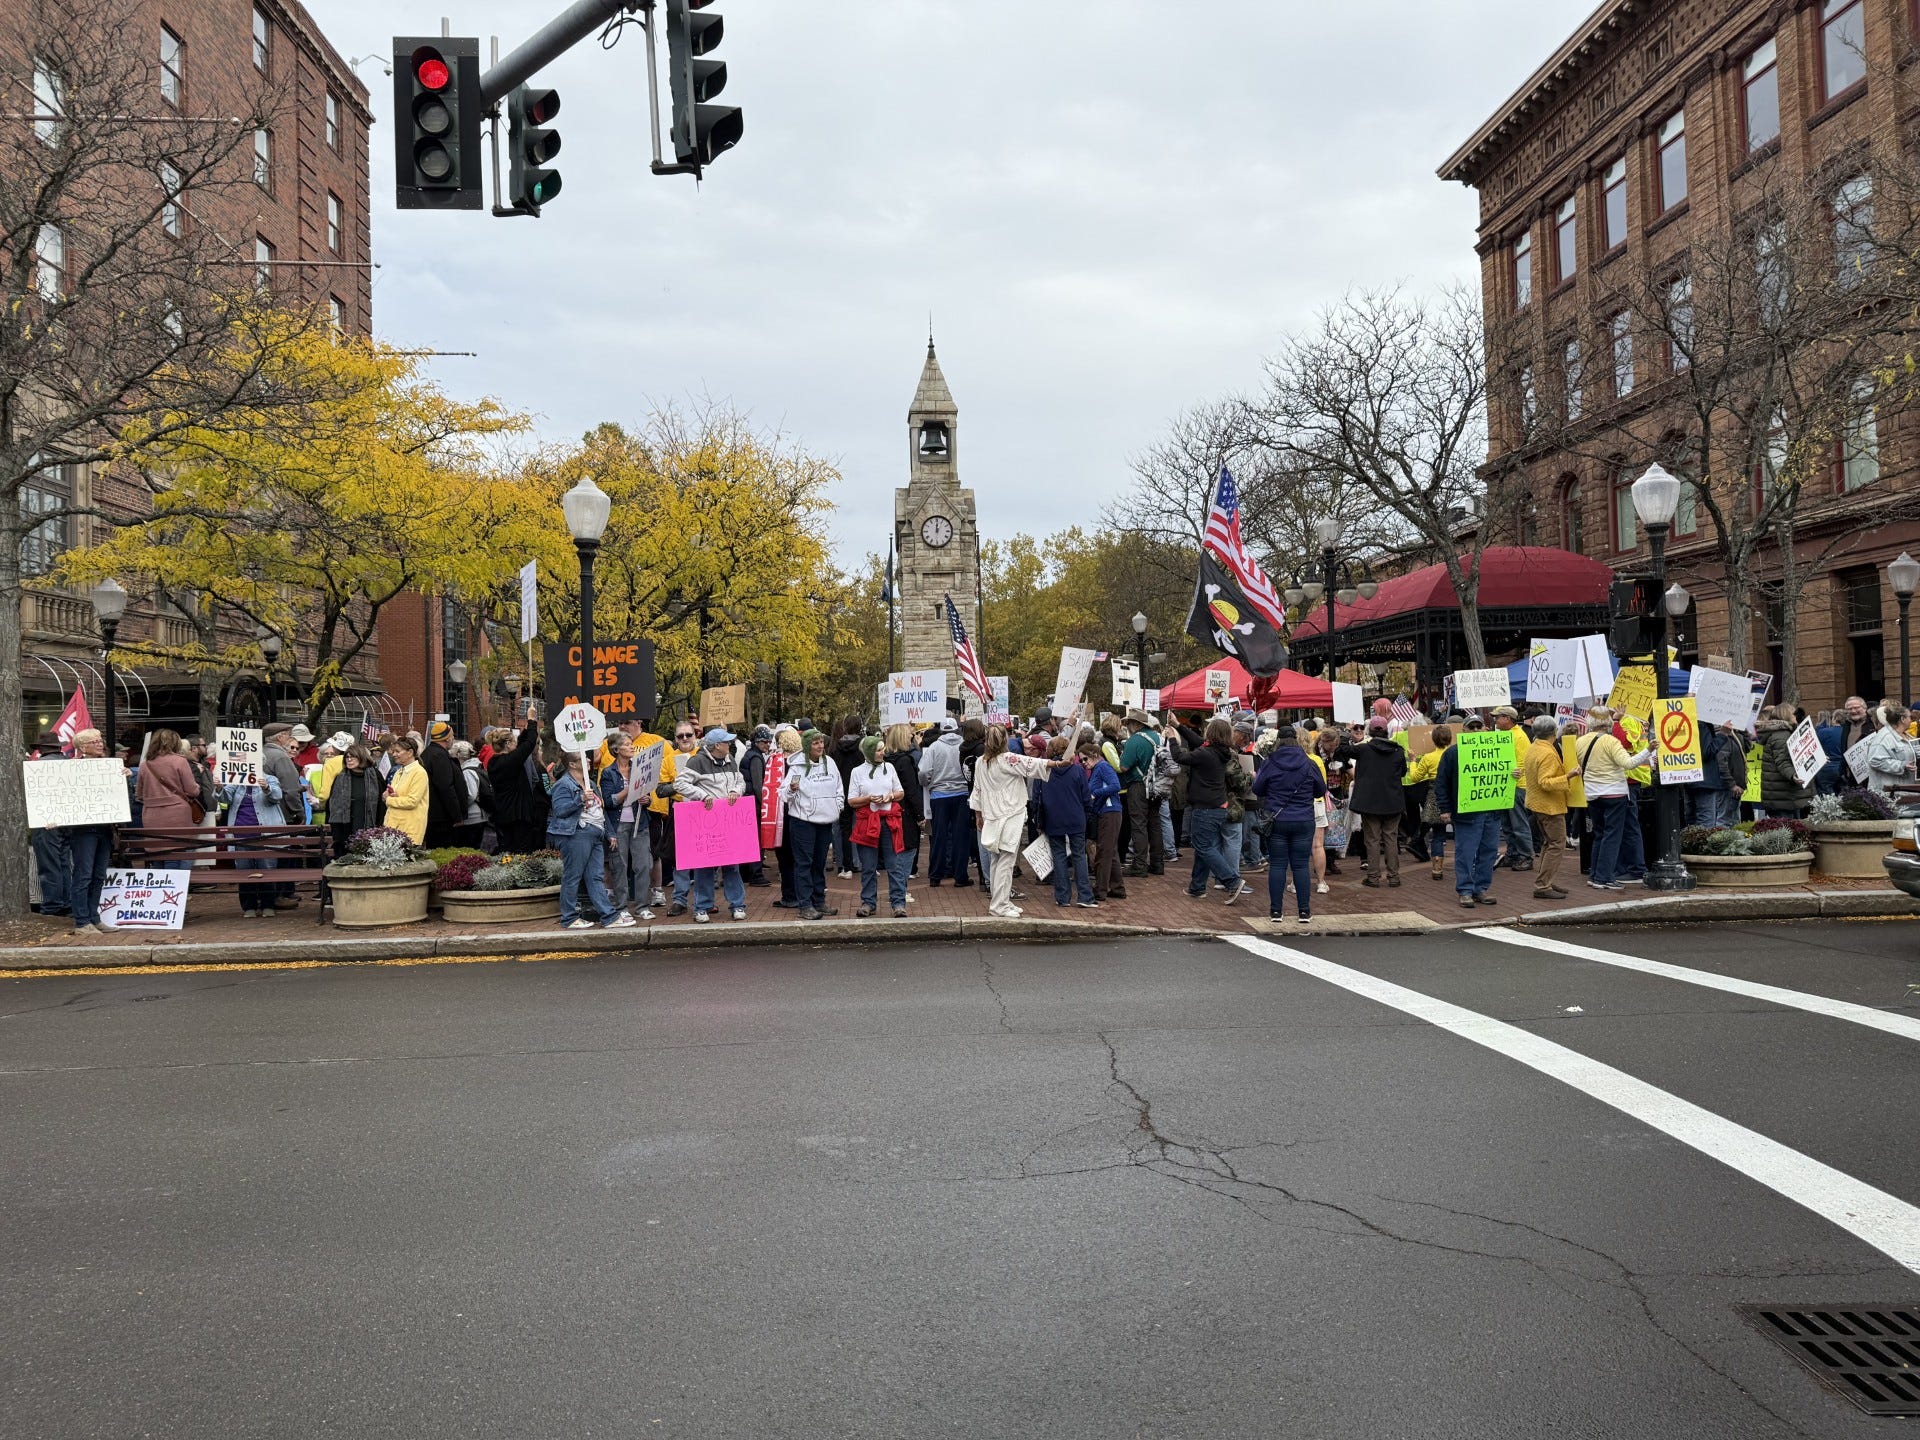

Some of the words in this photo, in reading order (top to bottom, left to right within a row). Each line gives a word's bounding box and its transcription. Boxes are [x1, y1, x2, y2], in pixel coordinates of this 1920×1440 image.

[1479, 611, 1549, 625] ENTERWAY
[569, 645, 639, 666] OANGE
[1531, 657, 1549, 672] NO
[911, 676, 922, 687] NO
[1210, 680, 1227, 688] KINGS
[1531, 673, 1572, 690] KINGS
[1474, 683, 1507, 697] KINGS
[1612, 686, 1632, 704] FIX
[895, 692, 914, 704] FAUX
[918, 691, 938, 703] KING
[1666, 700, 1683, 712] NO
[571, 710, 585, 721] NO
[907, 707, 924, 719] WAY
[565, 720, 595, 733] KINGS
[230, 730, 246, 740] NO
[221, 741, 258, 752] KINGS
[1472, 748, 1500, 759] FIGHT
[1663, 754, 1696, 766] KINGS
[26, 760, 65, 774] WHY
[221, 762, 256, 772] SINCE
[641, 762, 651, 773] THE
[1463, 761, 1511, 773] AGAINST
[27, 774, 95, 789] BECAUSE
[221, 772, 257, 784] 1776
[634, 771, 652, 791] USA
[1471, 774, 1508, 786] TRUTH
[27, 788, 77, 798] EASIER
[85, 787, 113, 795] THAN
[1470, 786, 1507, 801] DECAY
[35, 804, 96, 816] SOMEONE
[103, 803, 120, 812] IN
[42, 814, 79, 824] YOUR
[85, 812, 125, 821] ATTIC
[688, 811, 718, 831] NO
[124, 891, 152, 899] STAND
